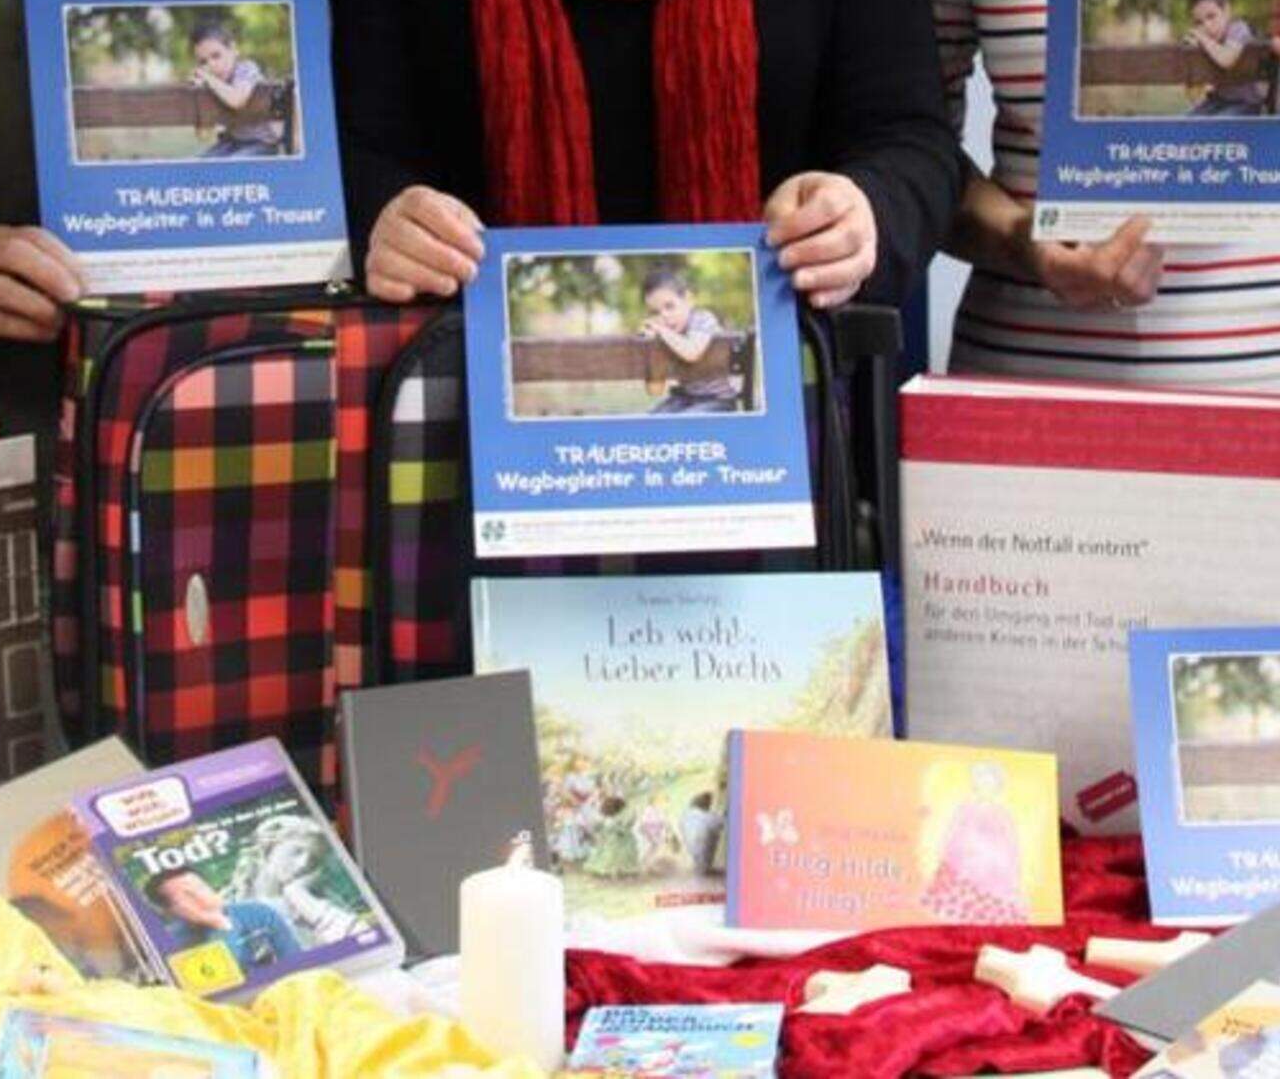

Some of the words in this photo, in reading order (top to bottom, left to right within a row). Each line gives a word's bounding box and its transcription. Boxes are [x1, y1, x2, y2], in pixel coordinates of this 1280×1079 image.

[1107, 143, 1249, 162] TRAUERKOFFER
[1057, 166, 1169, 188] Wegbegleiter
[1177, 166, 1193, 182] in
[1200, 166, 1230, 183] der
[116, 184, 271, 207] TRAUERKOFFER
[64, 212, 189, 236] Wegbegleiter
[197, 212, 214, 227] in
[223, 210, 254, 228] der
[263, 207, 327, 225] Trauer
[555, 441, 727, 464] TRAUERKOFFER
[496, 471, 633, 495] Wegbegleiter
[645, 469, 662, 486] in
[672, 467, 708, 486] der
[720, 464, 788, 484] Trauer
[978, 536, 1006, 551] der
[1013, 534, 1072, 553] Notfall
[923, 573, 1049, 597] Handbuch
[607, 614, 663, 648] Leb
[693, 648, 783, 683] Dachs
[132, 829, 230, 875] Tod?
